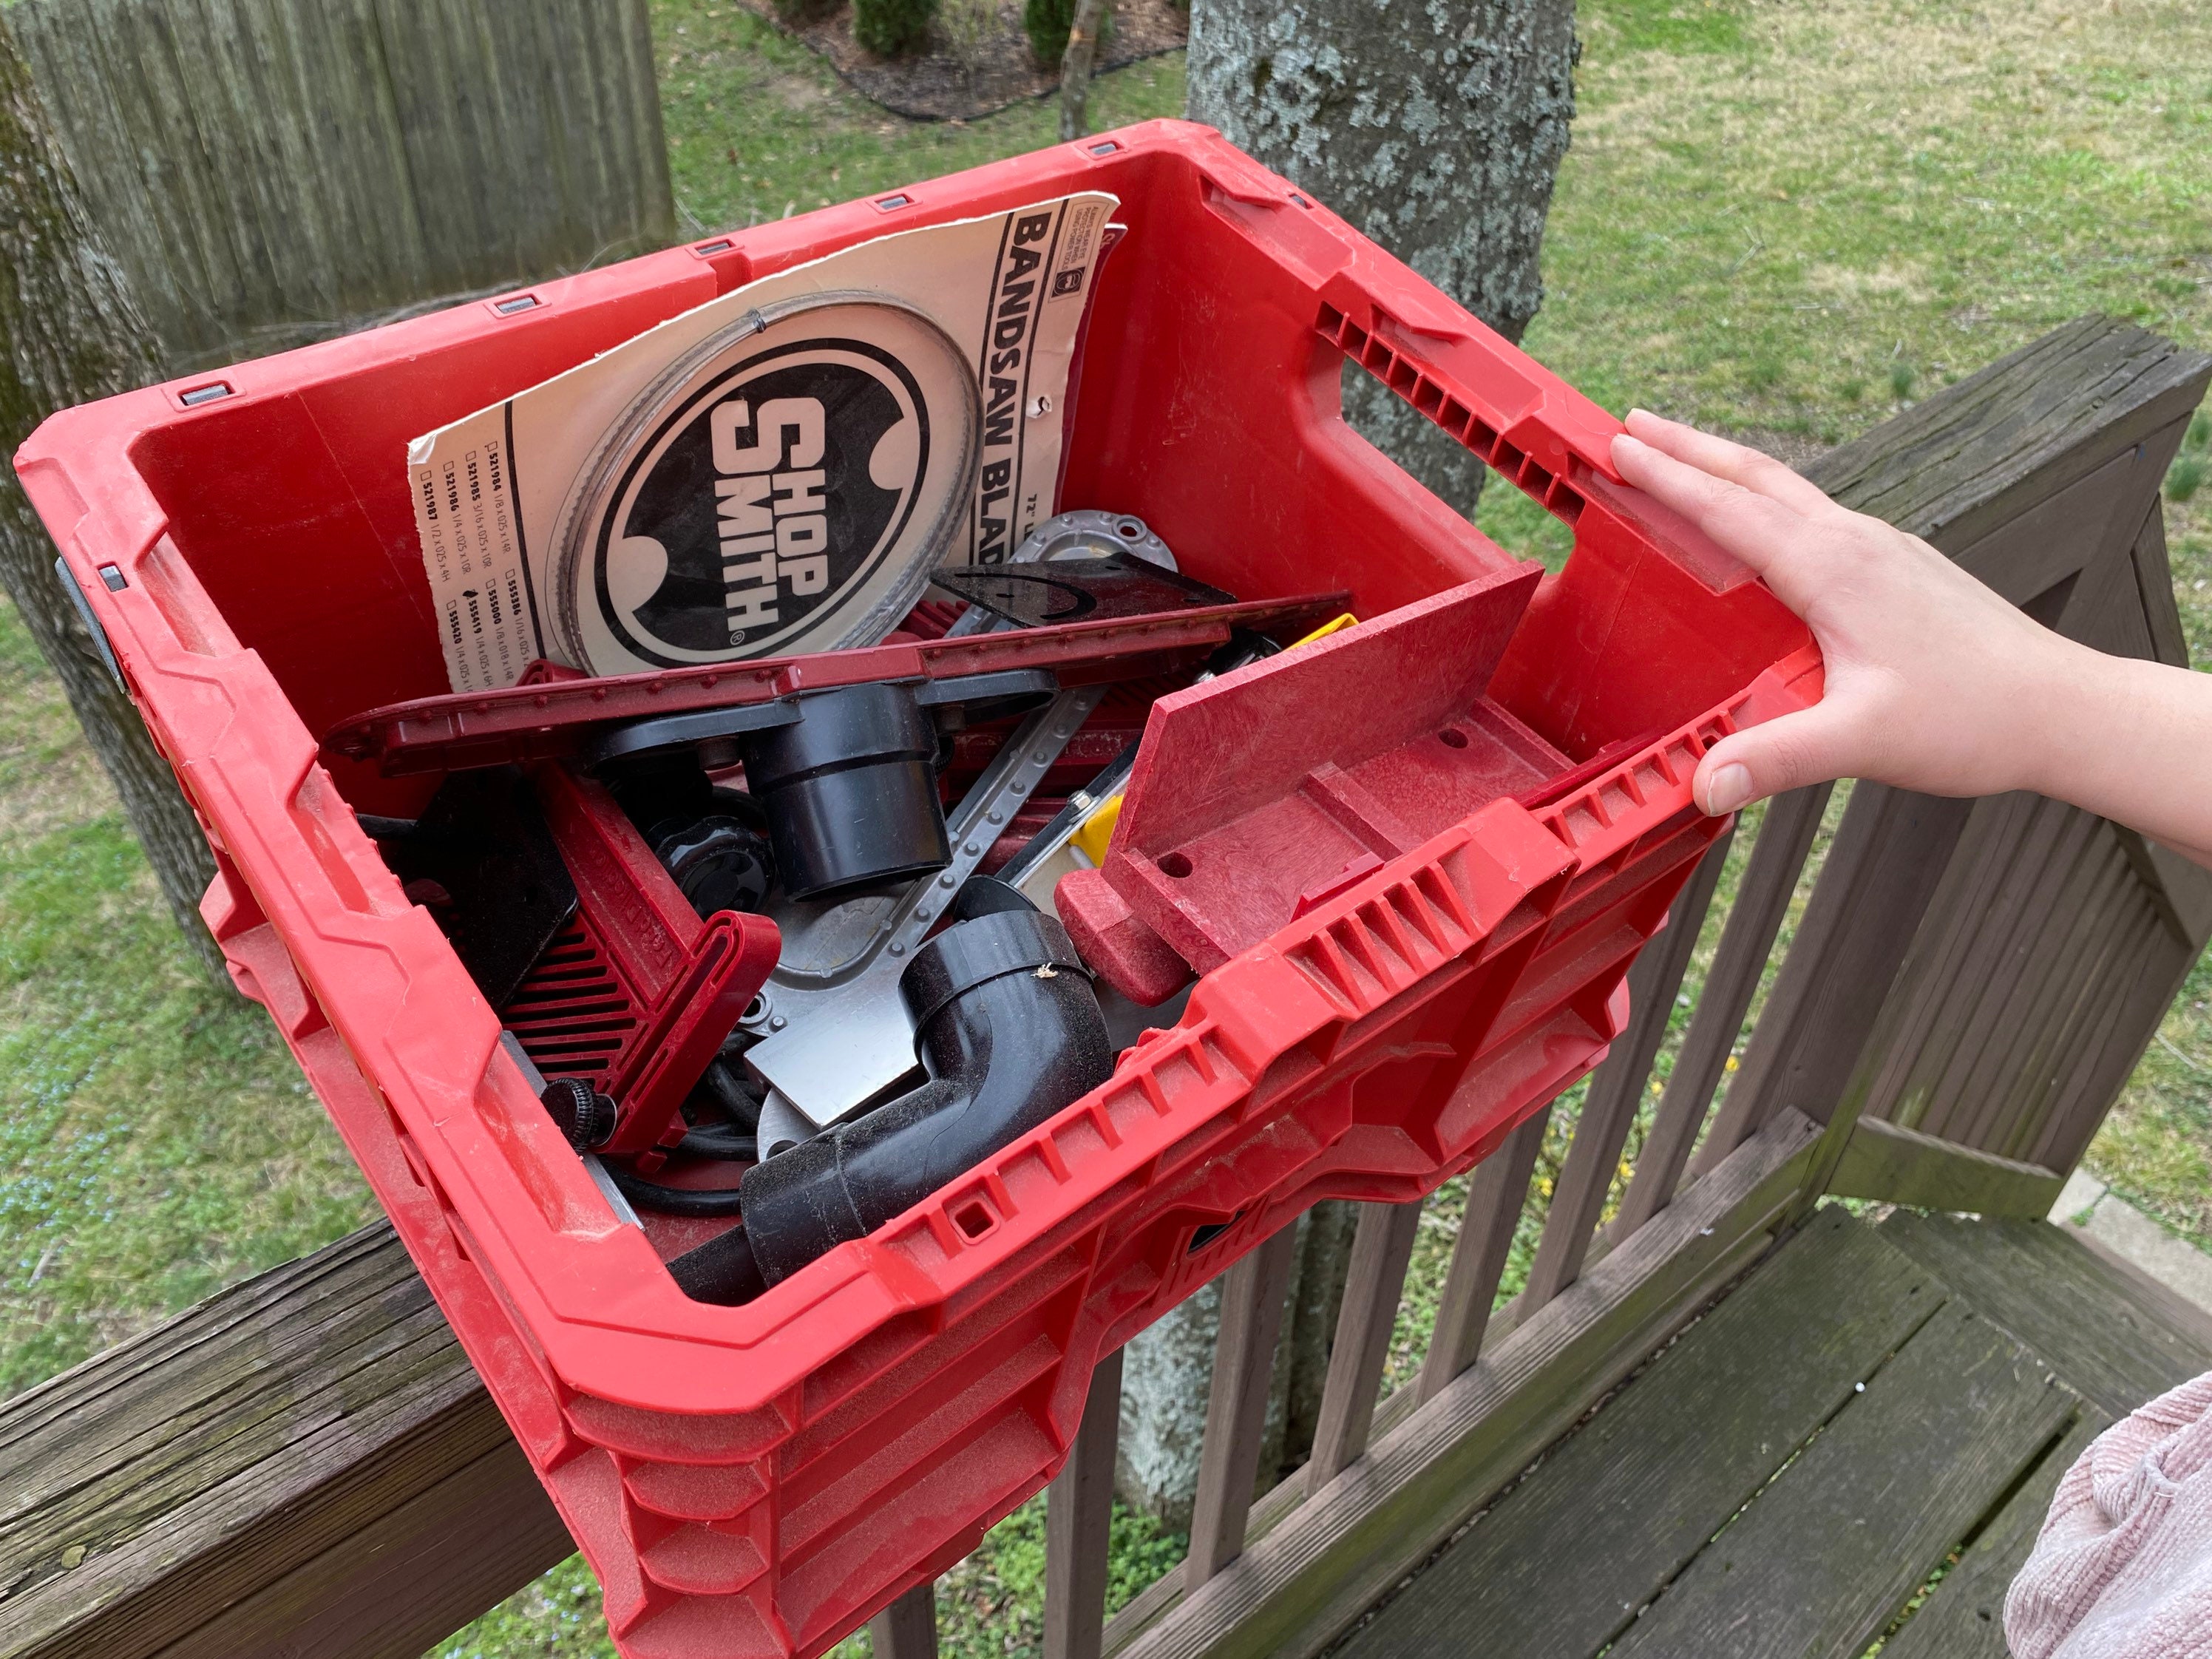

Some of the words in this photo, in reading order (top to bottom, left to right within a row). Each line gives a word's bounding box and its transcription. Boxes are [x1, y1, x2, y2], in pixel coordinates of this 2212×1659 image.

[1073, 208, 1083, 227] USING
[1086, 206, 1099, 228] ALWAYS
[1076, 207, 1090, 245] PROTECTION
[1068, 228, 1077, 251] POWER
[1082, 230, 1090, 247] WEAR
[1062, 251, 1071, 270] TOOLS
[1071, 246, 1079, 263] WHEN
[984, 211, 1052, 446] BANDSAW
[489, 452, 501, 491] 521984
[467, 462, 481, 501] 521985
[445, 472, 459, 512] 521986
[423, 482, 438, 520] 521987
[495, 494, 503, 509] 1/8
[473, 503, 484, 523] 3/16
[979, 458, 1011, 565] BLAD
[452, 514, 462, 528] 1/4
[498, 515, 507, 531] 025
[431, 524, 441, 538] 1/2
[478, 530, 488, 546] 025
[457, 535, 467, 552] 025
[501, 539, 511, 554] 14R
[435, 546, 447, 562] 025
[482, 553, 492, 569] 10R
[461, 559, 471, 574] 10R
[441, 570, 450, 582] 4H
[488, 589, 502, 625] 555000
[469, 600, 482, 634] 555419
[508, 580, 521, 615] 555386
[515, 617, 525, 634] 1/16
[520, 641, 529, 655] 025
[449, 610, 462, 644] 555420
[495, 627, 505, 639] 1/8
[476, 637, 485, 648] 1/4
[456, 646, 466, 658] 1/4
[499, 645, 509, 659] 018
[479, 655, 489, 669] 025
[460, 664, 469, 679] 025
[503, 667, 514, 680] 14R
[484, 676, 493, 686] 6H
